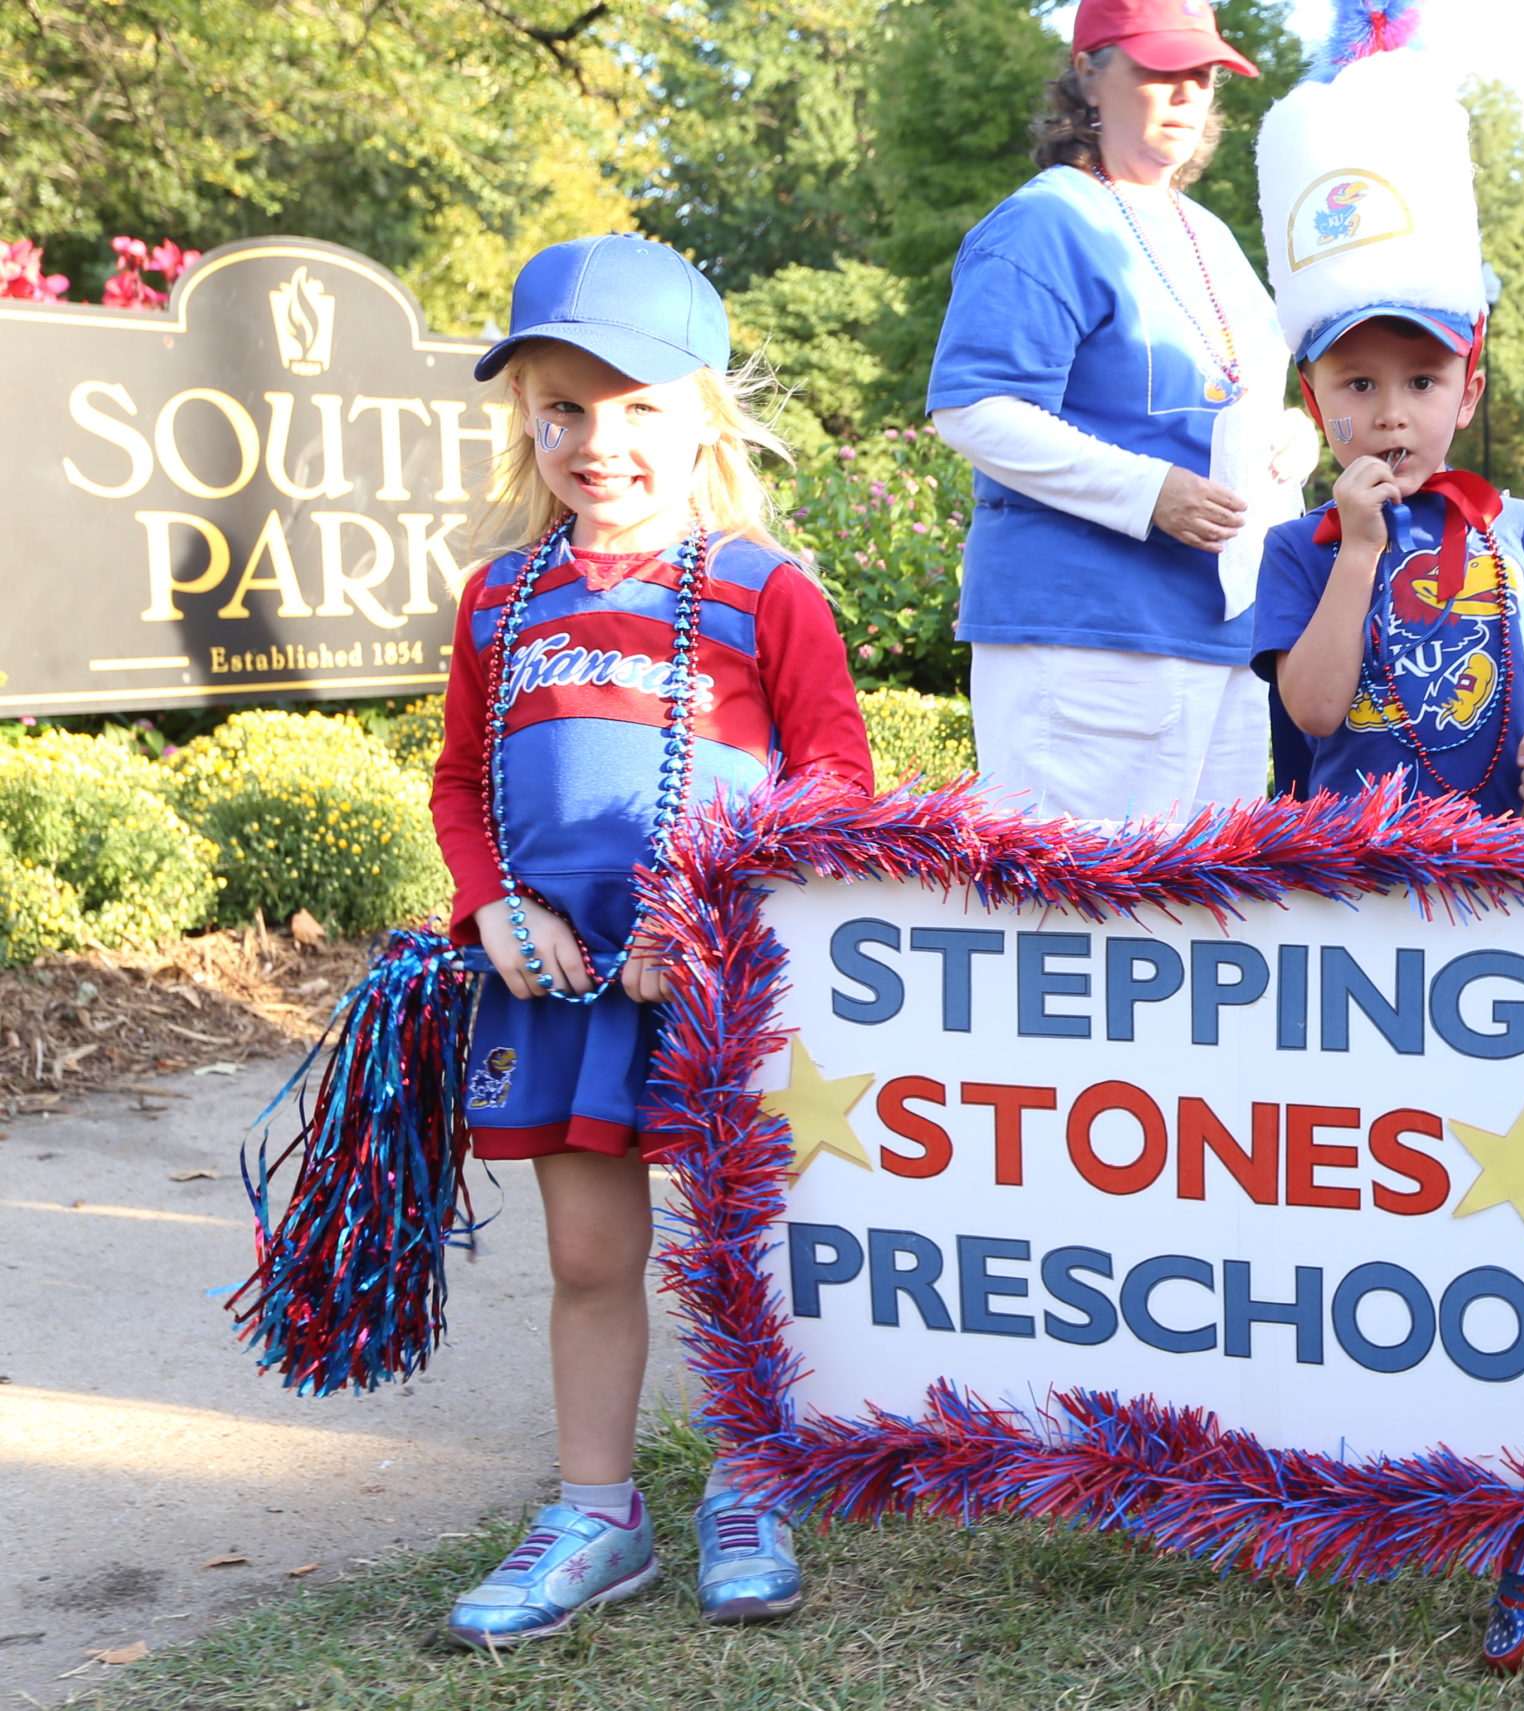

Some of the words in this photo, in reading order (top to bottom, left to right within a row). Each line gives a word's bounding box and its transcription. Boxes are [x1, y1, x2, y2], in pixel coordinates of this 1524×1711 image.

[63, 380, 516, 501] SOUTH
[134, 509, 469, 629] PARK
[211, 642, 364, 673] Established
[371, 640, 424, 667] 1854
[1388, 640, 1444, 677] KU
[876, 1074, 1452, 1216] STONES
